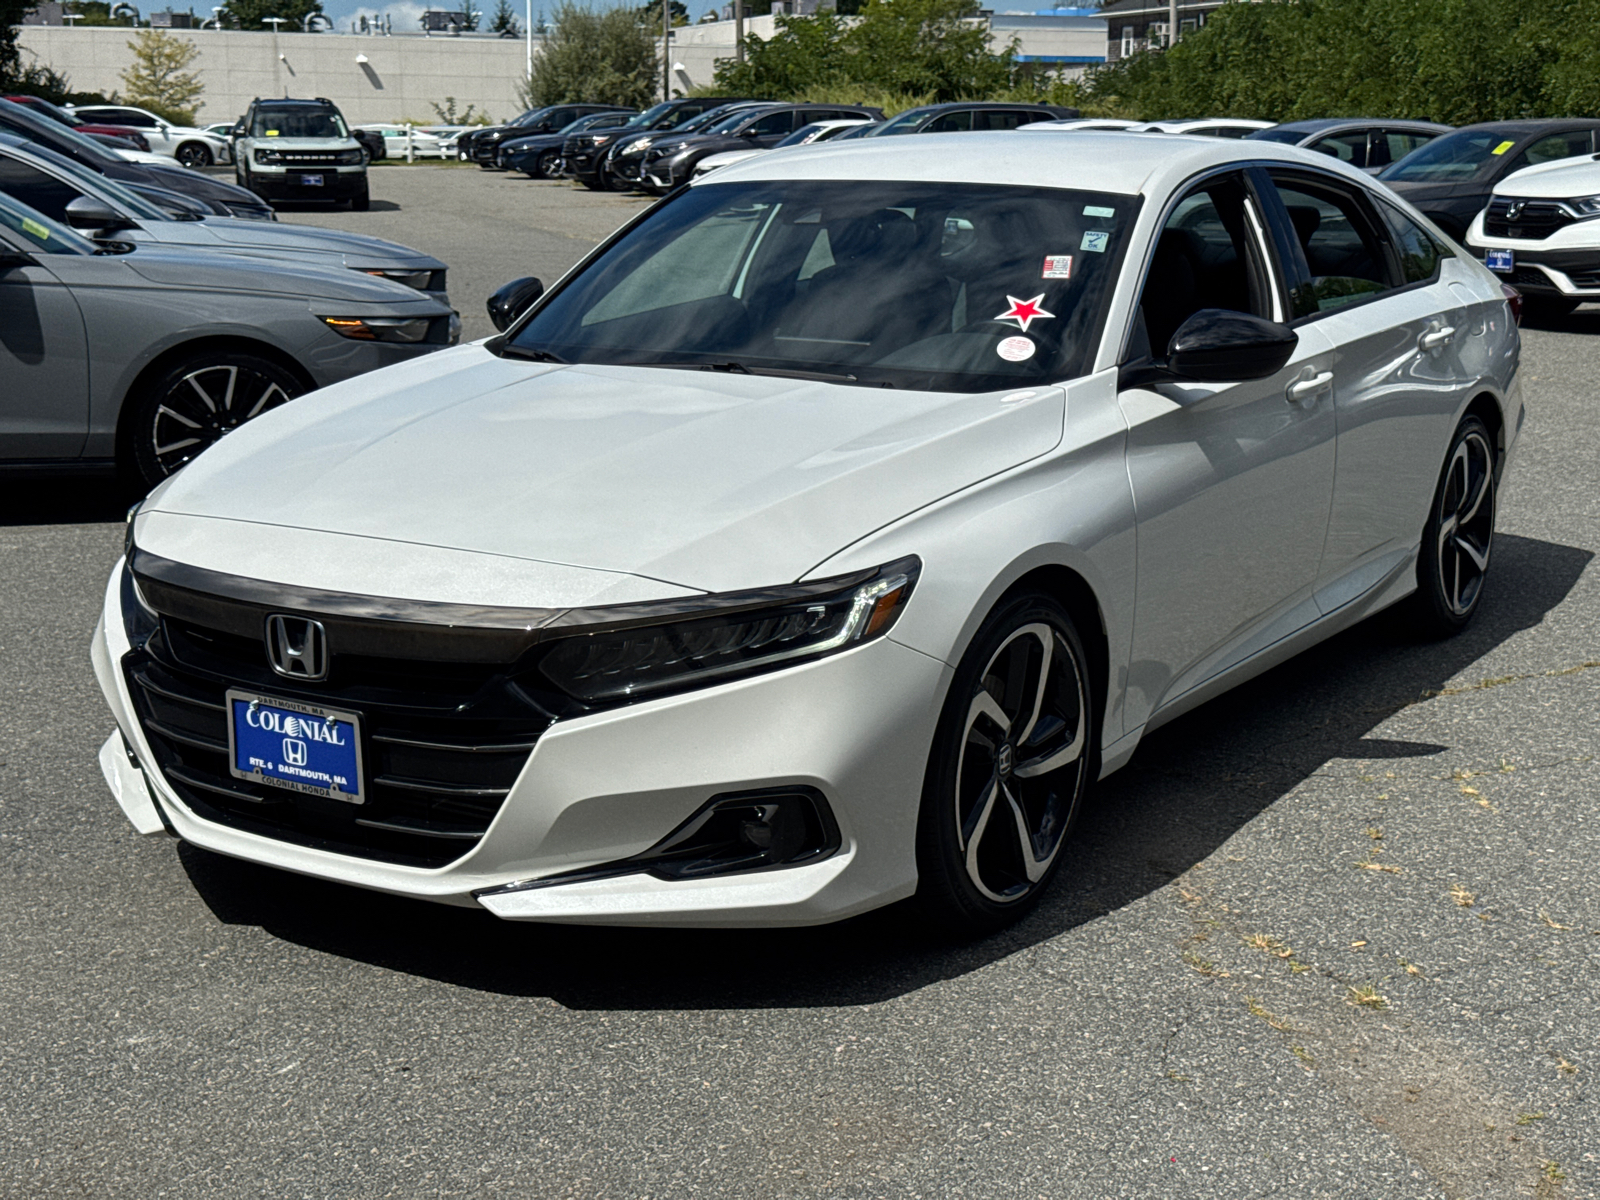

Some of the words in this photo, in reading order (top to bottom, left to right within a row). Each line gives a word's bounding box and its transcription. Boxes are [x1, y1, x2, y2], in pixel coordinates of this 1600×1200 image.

[311, 707, 325, 716] MA
[246, 707, 345, 746] COLONIAL
[249, 757, 266, 768] RTE.
[267, 761, 273, 770] 6
[278, 764, 332, 784] DARTMOUTH,
[333, 775, 347, 785] MA
[262, 776, 300, 791] COLONIAL
[301, 784, 331, 797] HONDA
